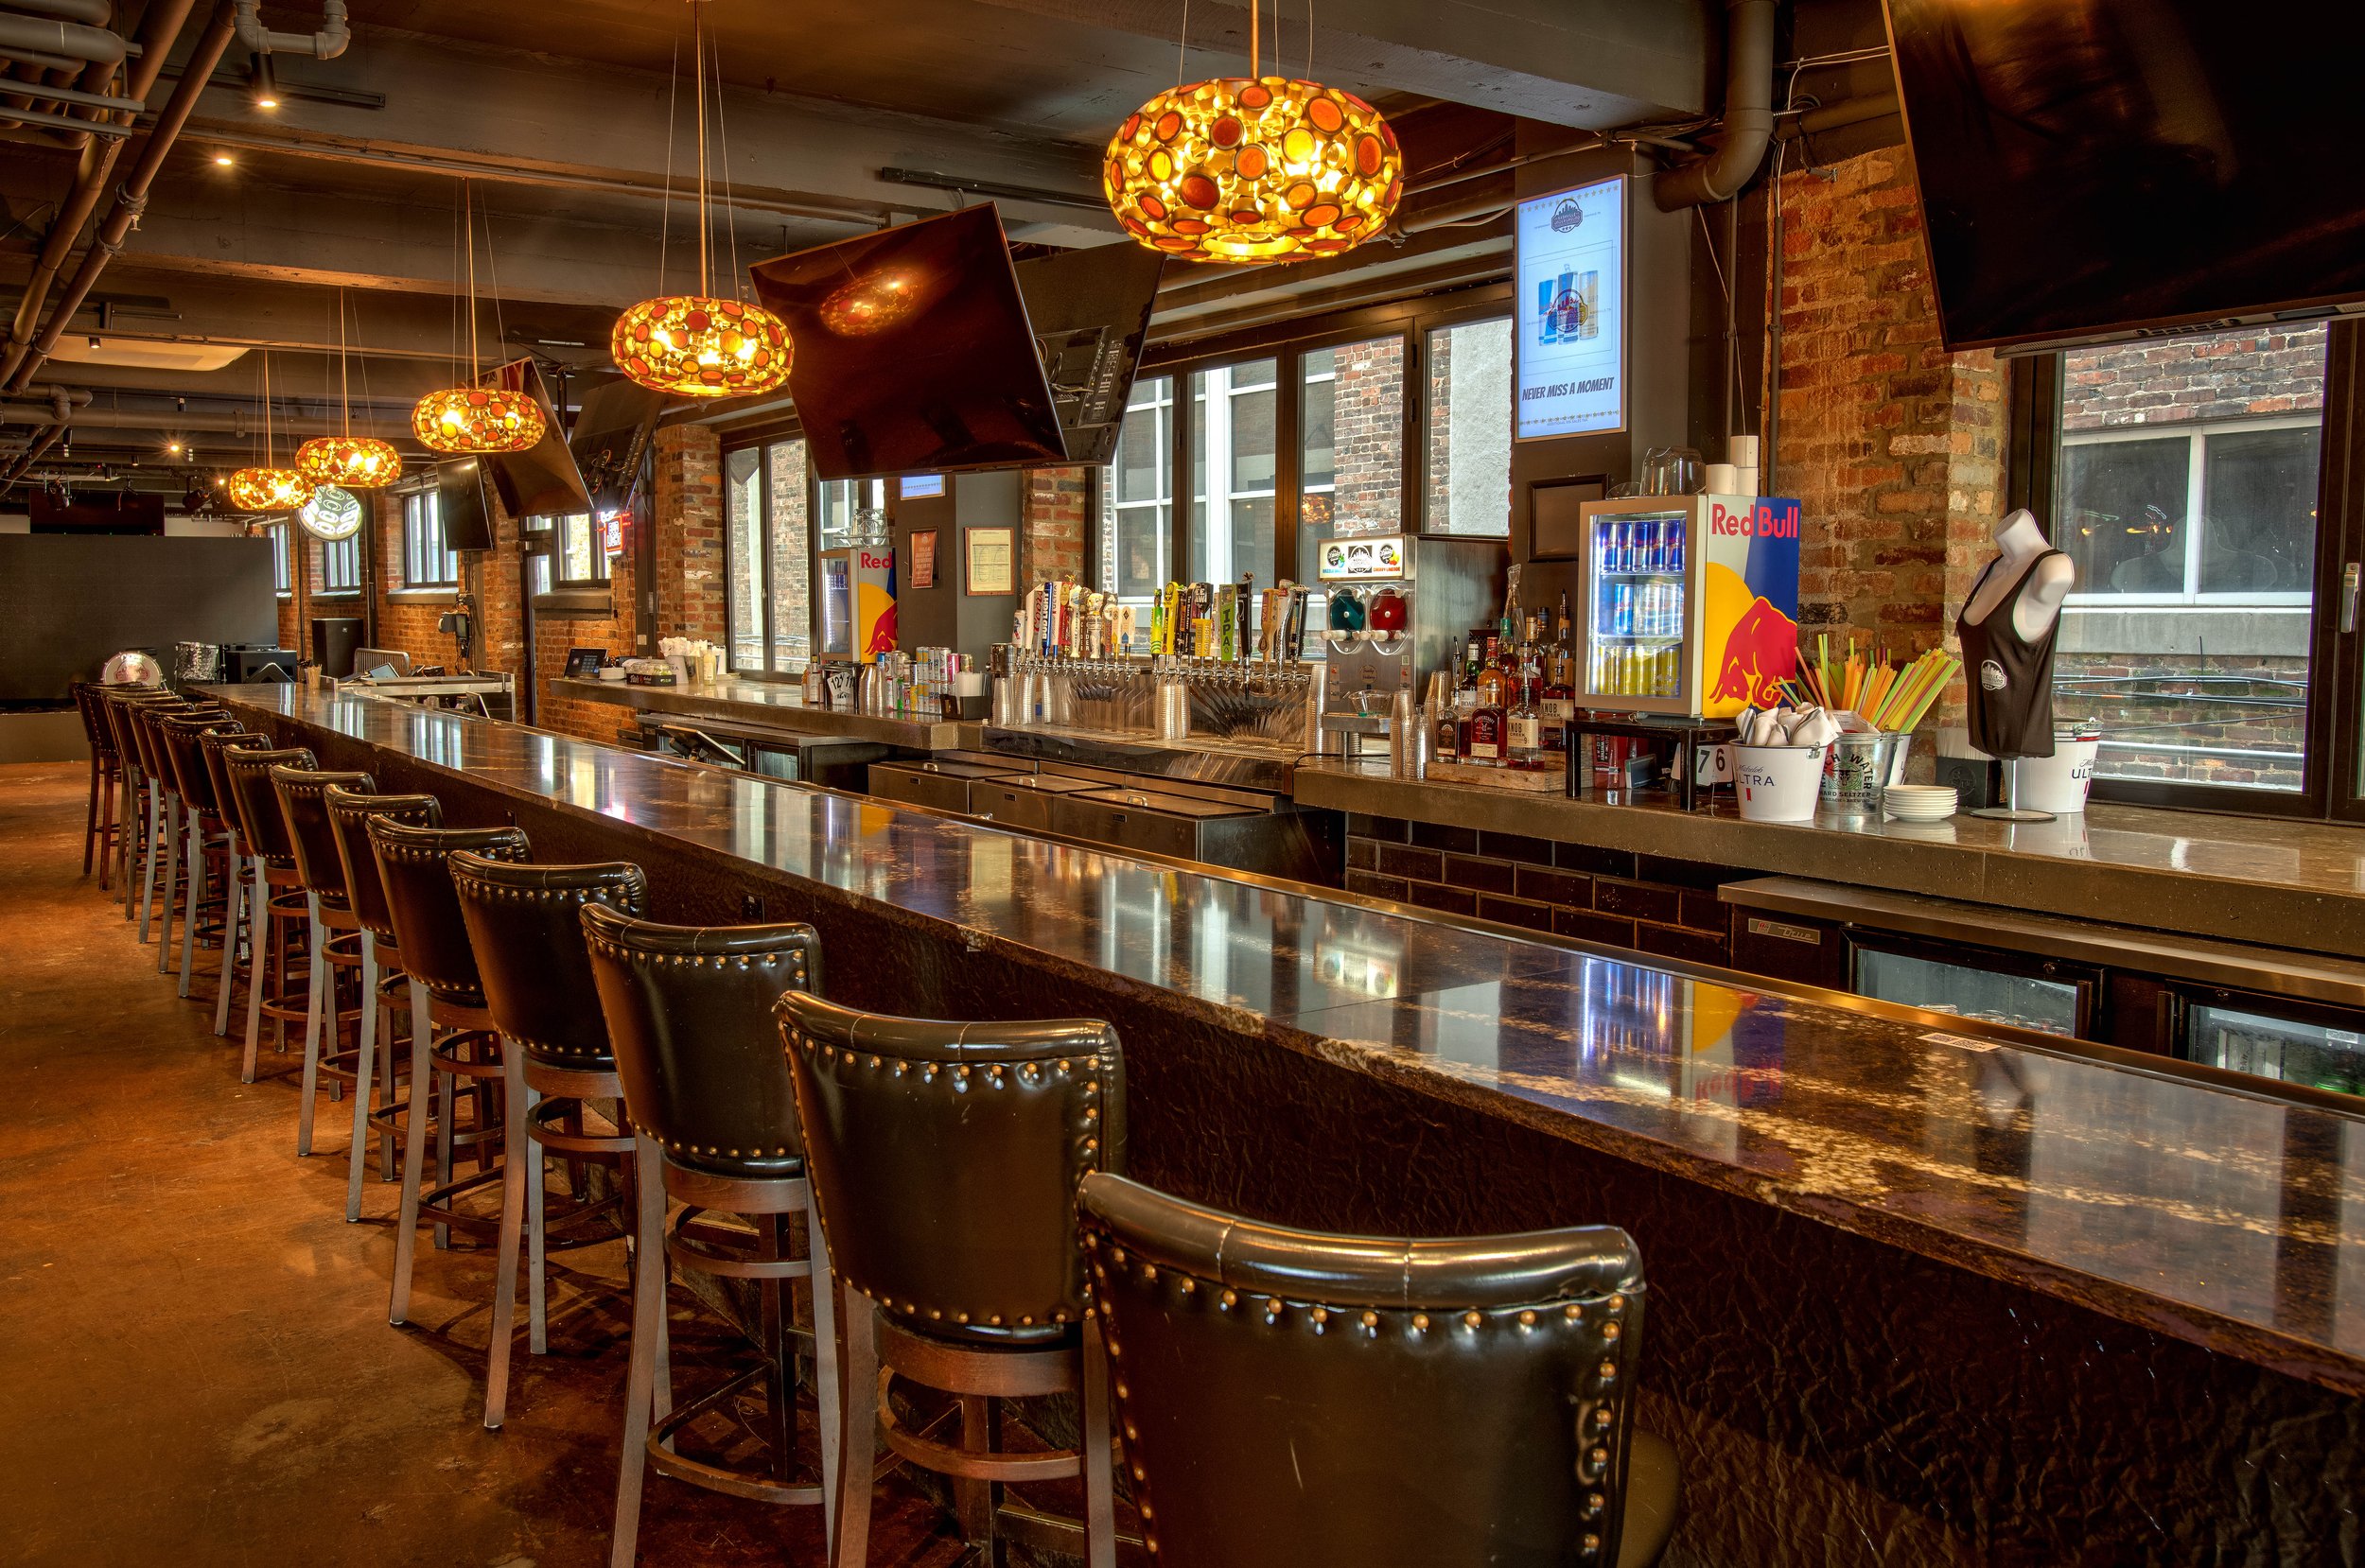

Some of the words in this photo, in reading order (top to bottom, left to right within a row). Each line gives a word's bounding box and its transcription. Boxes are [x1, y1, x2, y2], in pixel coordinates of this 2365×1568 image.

[1522, 386, 1546, 401] NEVER
[1547, 383, 1568, 398] MISS
[1569, 381, 1576, 394] A
[1576, 376, 1615, 393] MOMENT
[1711, 503, 1755, 536] Red
[1758, 507, 1798, 538] Bull
[861, 551, 893, 568] Red
[1222, 608, 1232, 646] IPA
[1541, 703, 1558, 713] KNOB
[1508, 722, 1522, 733] KNOB
[1736, 774, 1775, 787] LTRA
[1849, 754, 1874, 790] WATER
[2071, 768, 2092, 779] ULT
